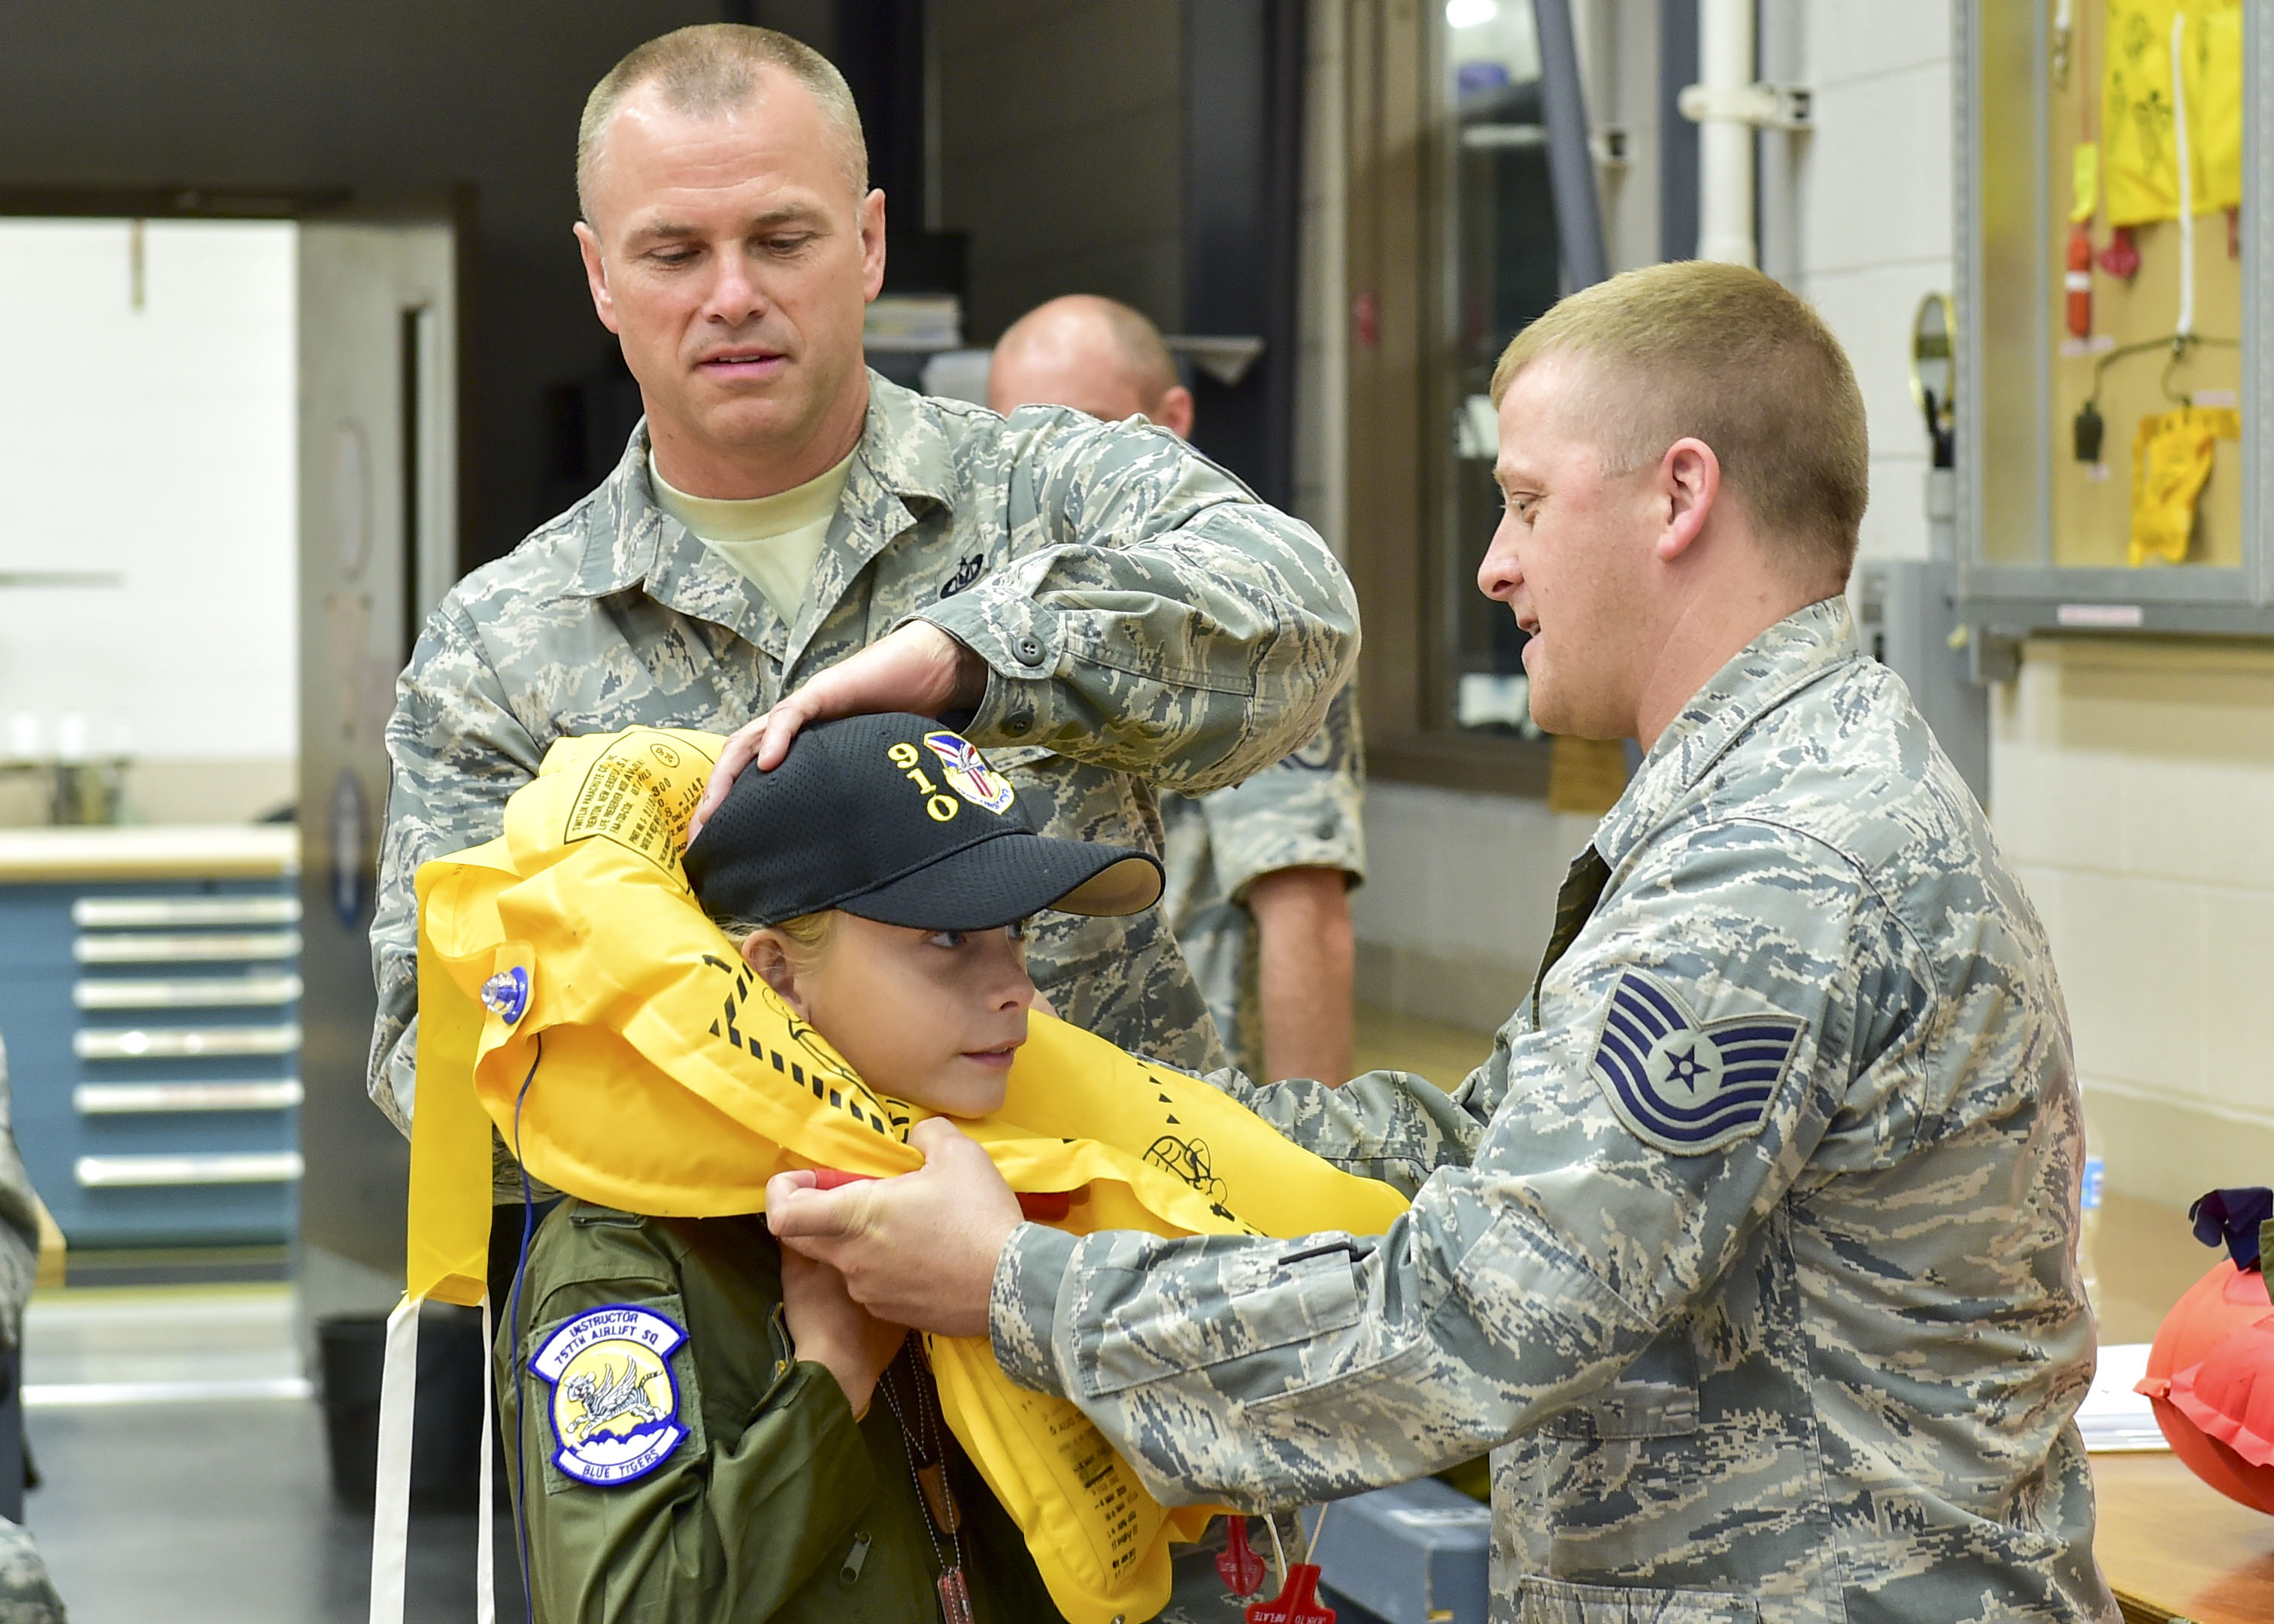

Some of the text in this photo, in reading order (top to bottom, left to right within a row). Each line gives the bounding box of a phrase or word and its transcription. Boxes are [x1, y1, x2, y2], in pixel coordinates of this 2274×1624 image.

[888, 743, 959, 821] 910
[569, 1311, 638, 1338] INSTRUCTOR
[554, 1325, 659, 1365] 757TH AIRLIFT SQ
[582, 1449, 659, 1479] BLUE TIGERS
[1254, 1610, 1287, 1623] INFLATE
